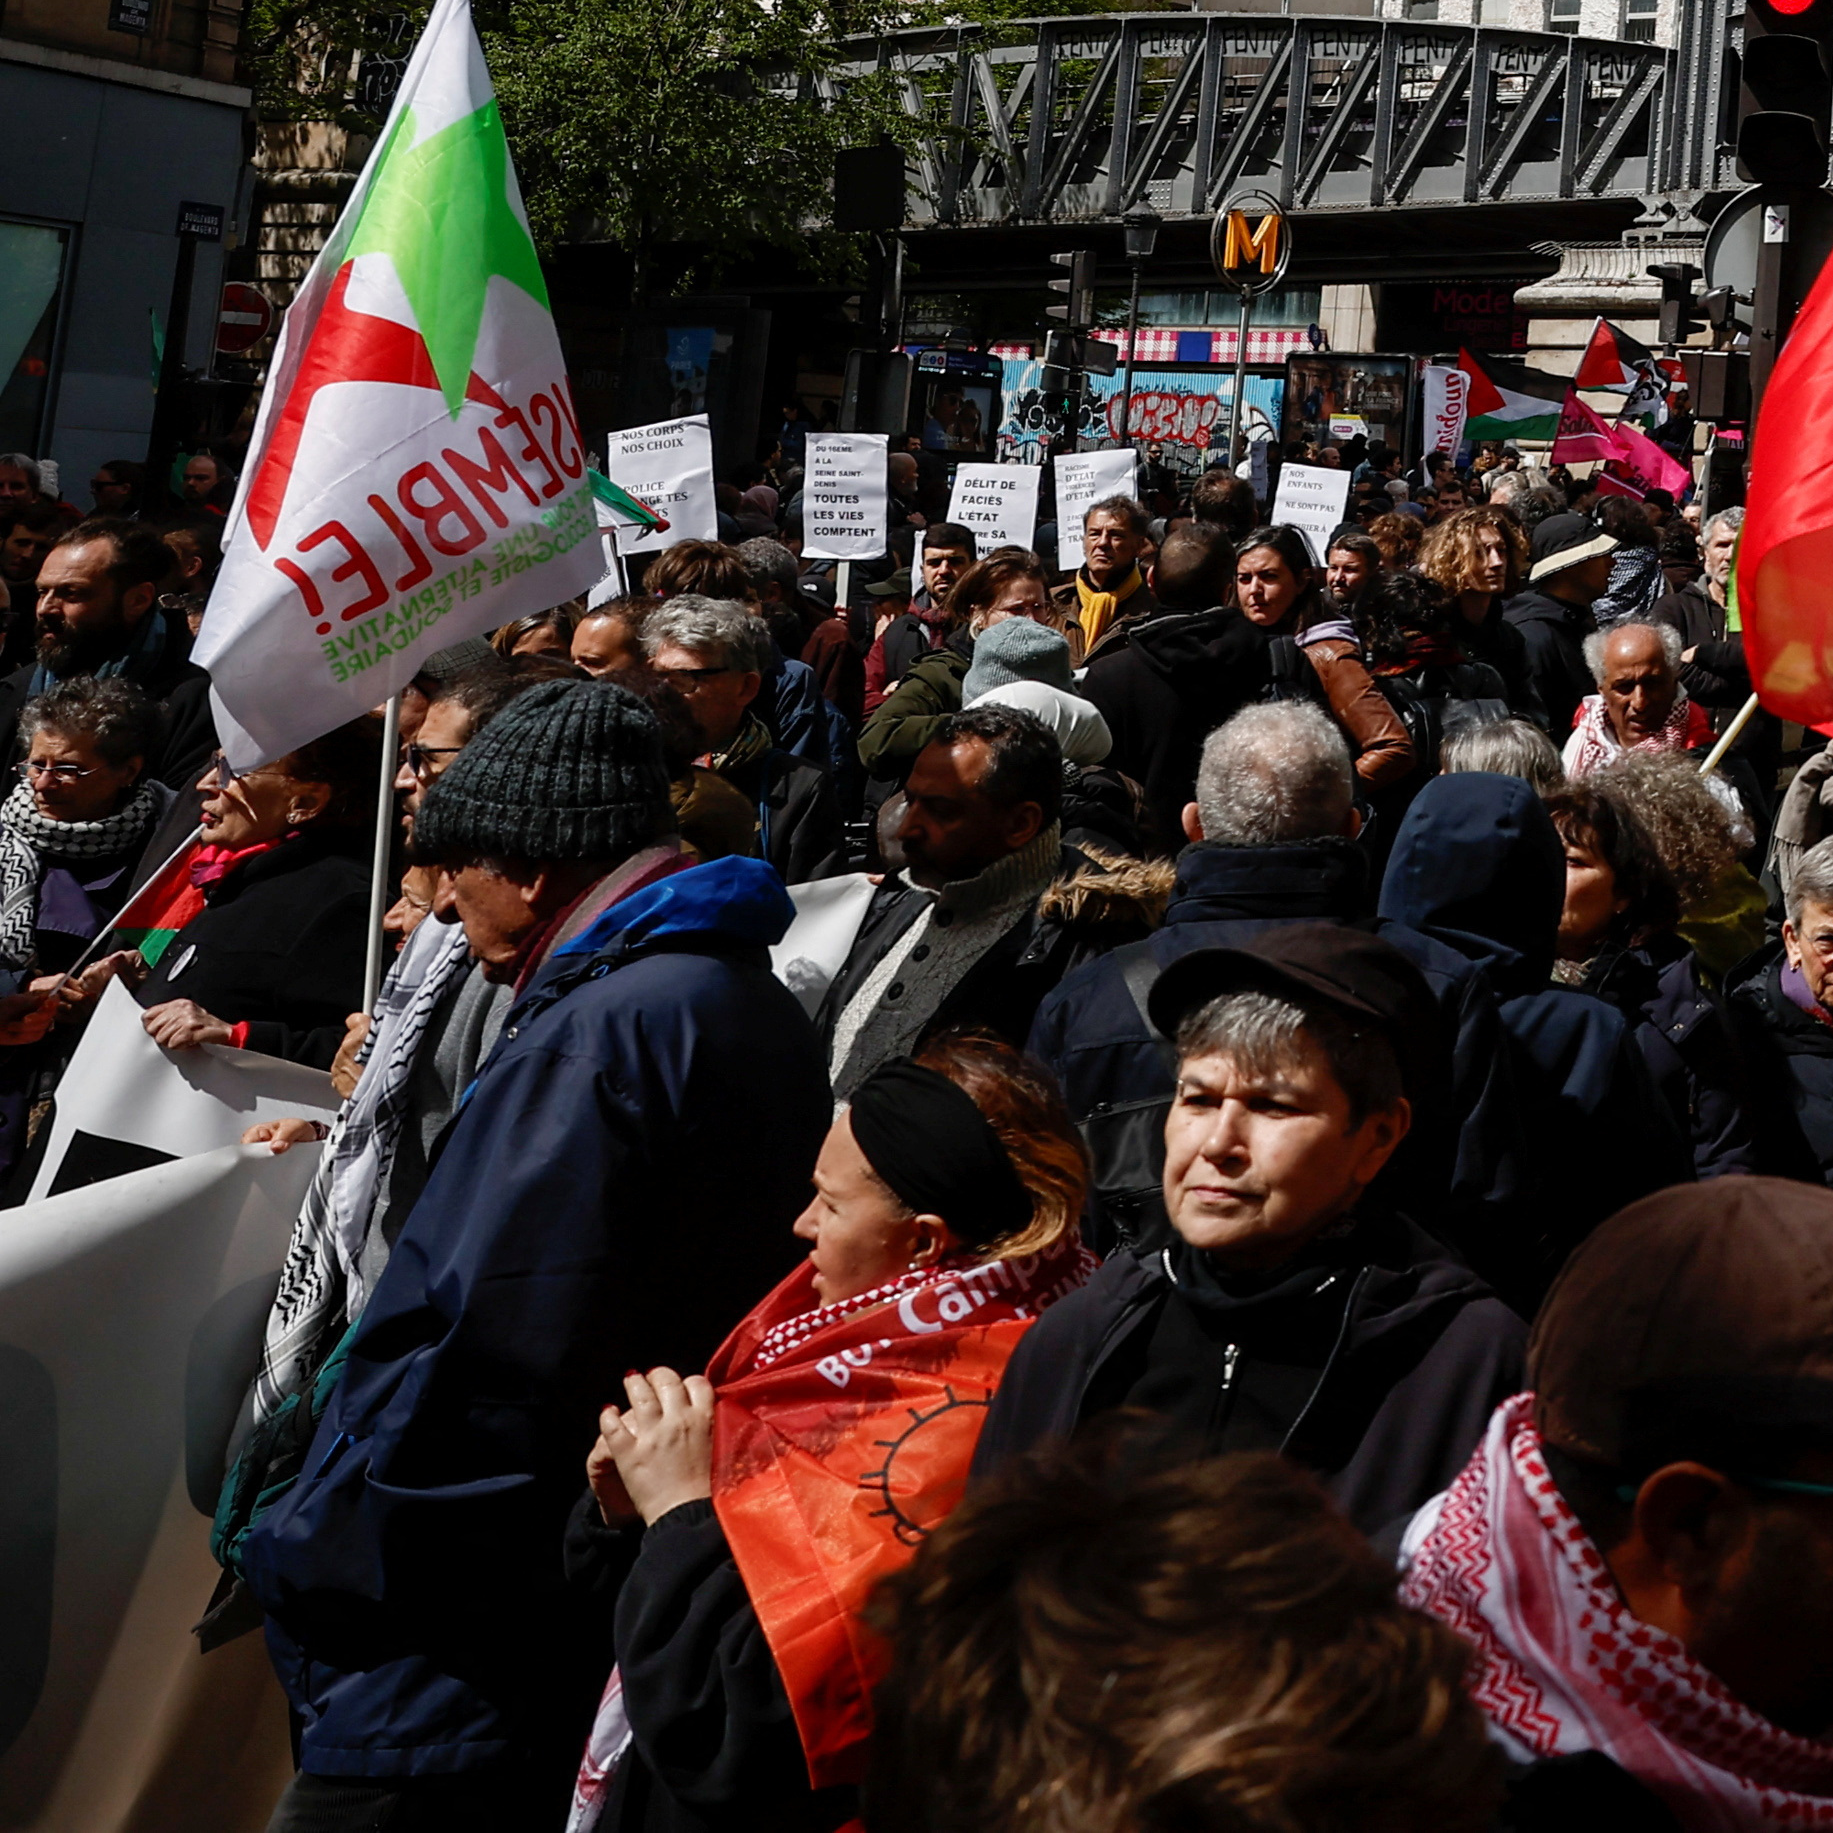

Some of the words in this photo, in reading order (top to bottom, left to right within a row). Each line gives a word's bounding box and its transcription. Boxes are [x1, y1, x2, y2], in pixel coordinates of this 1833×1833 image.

[1223, 211, 1280, 272] M
[621, 431, 644, 441] NOS
[646, 424, 685, 438] CORPS
[621, 444, 644, 455] NOS
[646, 438, 684, 451] CHOIX
[1289, 470, 1305, 478] NOS
[624, 482, 665, 494] POLICE
[814, 480, 837, 488] DENIS
[964, 478, 998, 489] DÉLIT
[1000, 480, 1016, 490] DE
[1287, 480, 1323, 491] ENFANTS
[666, 491, 688, 503] TES
[814, 494, 859, 504] TOUTES
[1285, 501, 1296, 509] NE
[1297, 502, 1319, 511] SONT
[1320, 505, 1336, 513] PAS
[813, 510, 835, 520] LES
[838, 511, 864, 521] VIES
[813, 527, 876, 537] COMPTENT
[990, 529, 1007, 539] SA
